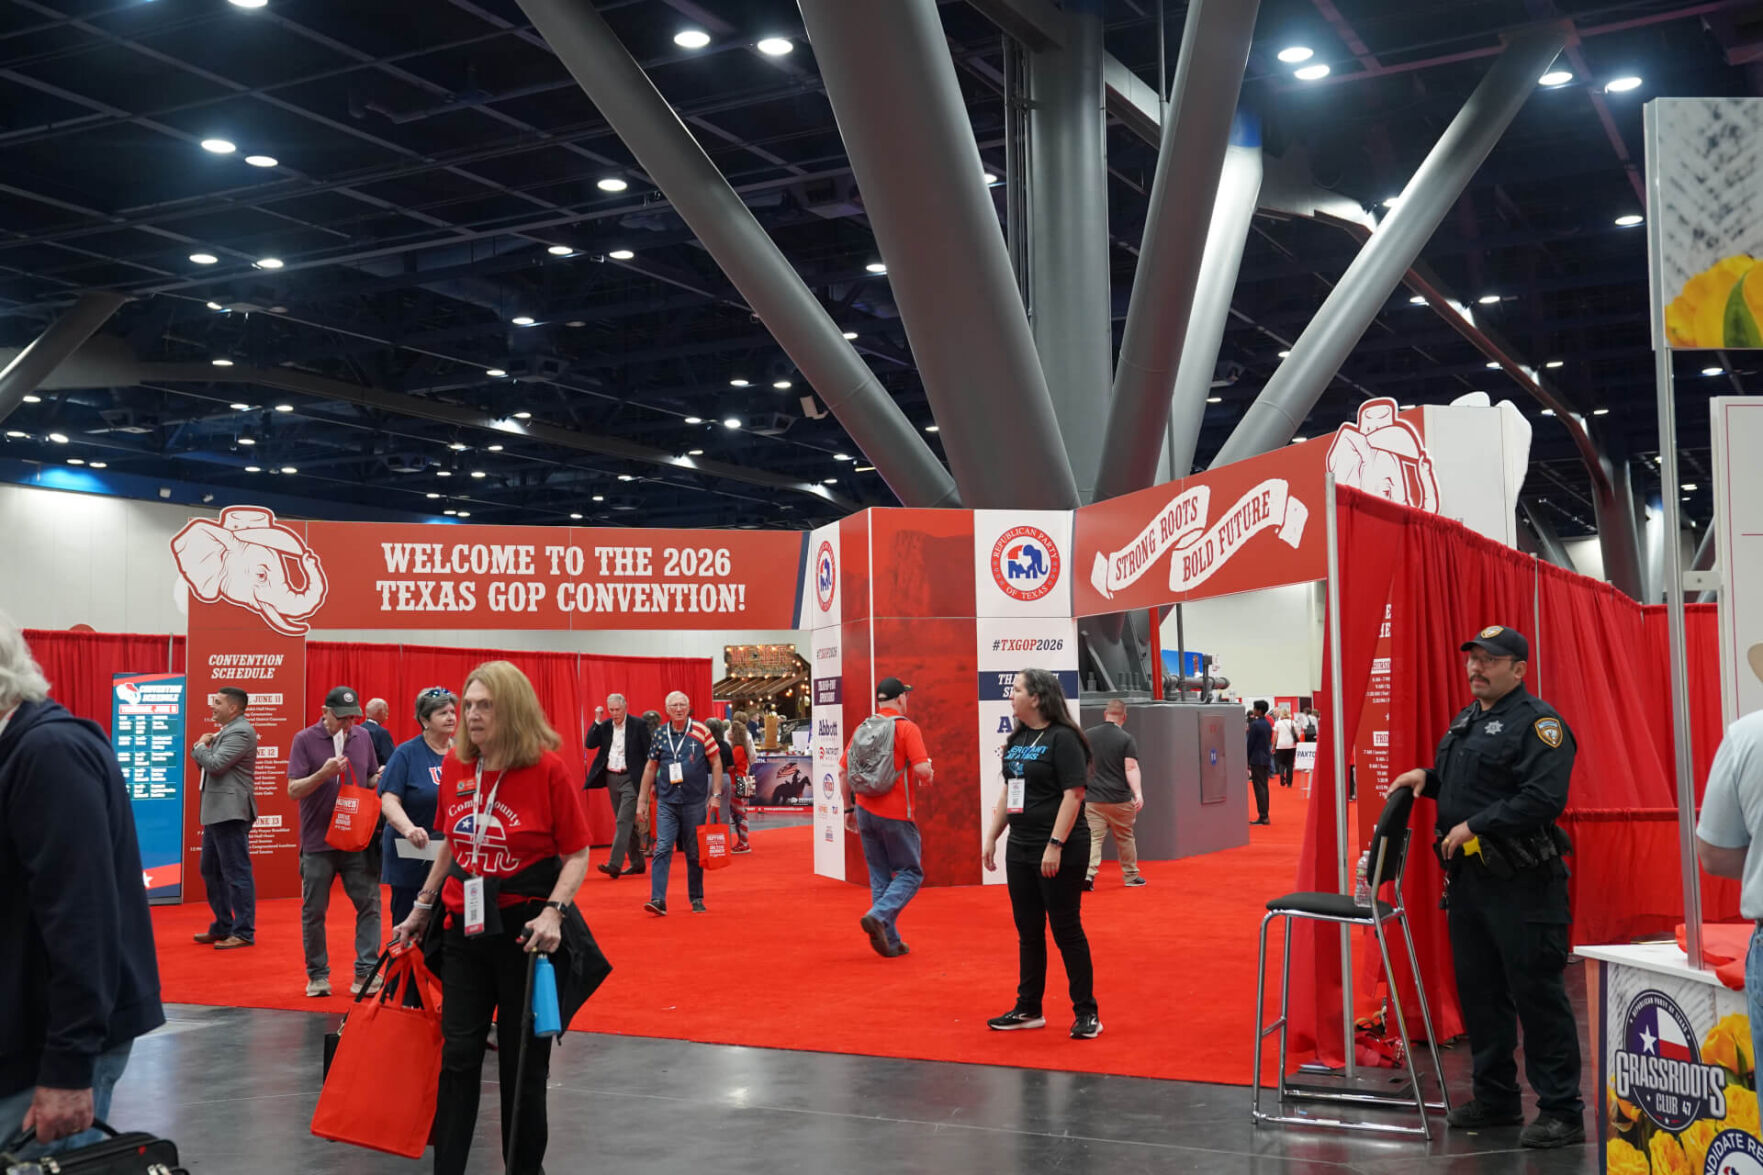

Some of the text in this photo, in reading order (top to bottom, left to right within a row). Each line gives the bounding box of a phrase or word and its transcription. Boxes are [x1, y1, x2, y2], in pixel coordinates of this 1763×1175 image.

[992, 527, 1058, 559] REPUBLICAN PARTY
[1115, 496, 1198, 581] STRONG ROOTS
[1182, 490, 1271, 582] BOLD FUTURE
[381, 542, 732, 577] WELCOME TO THE 2026
[375, 580, 747, 613] TEXAS GOP CONVENTION!
[1005, 586, 1049, 600] OF TEXAS
[208, 654, 285, 667] CONVENTION
[992, 639, 1064, 652] #TXGOP2026
[210, 667, 276, 680] SCHEDULE
[254, 695, 273, 704] JUNE
[268, 748, 275, 756] 12
[448, 794, 522, 827] Coml ounty
[1615, 1051, 1726, 1119] GRASSROOTS
[1655, 1093, 1692, 1117] CLUB 47
[1706, 1132, 1763, 1175] NDIDATE RE
